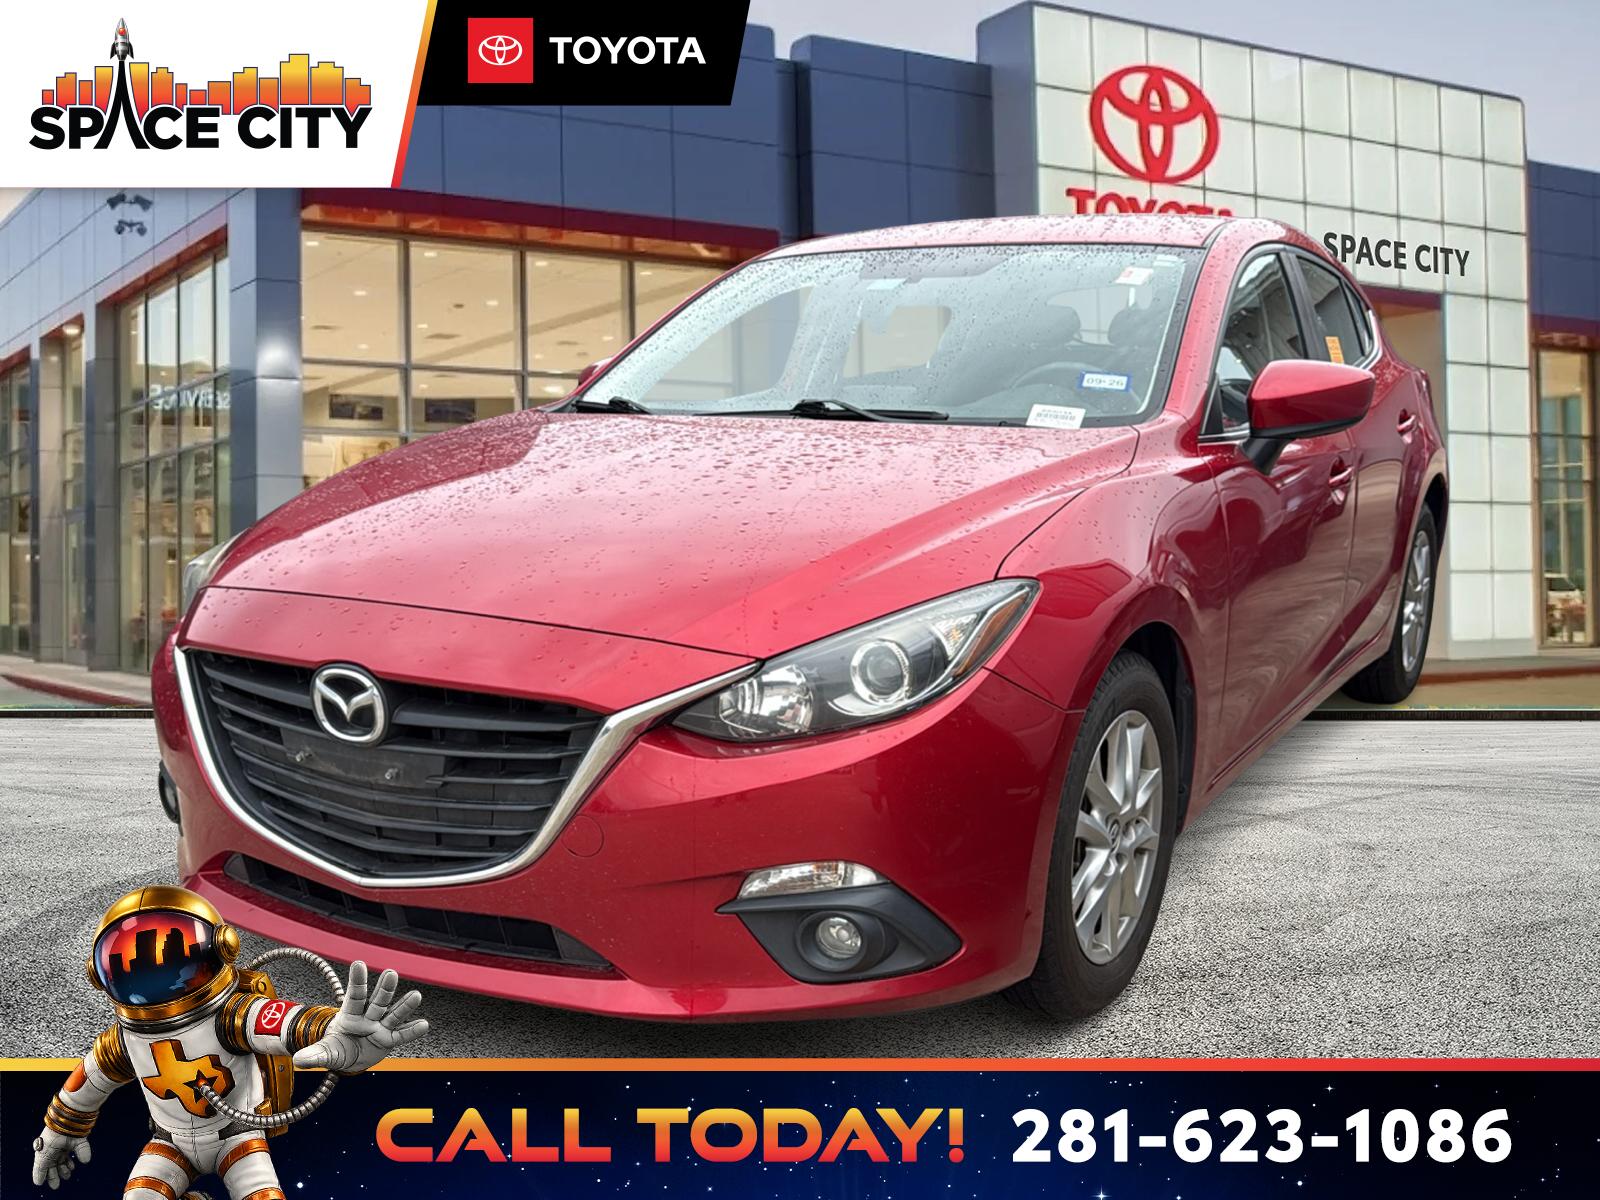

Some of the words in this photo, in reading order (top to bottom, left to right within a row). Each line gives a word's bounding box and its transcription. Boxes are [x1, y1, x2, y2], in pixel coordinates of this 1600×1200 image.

[1065, 187, 1233, 217] TOY
[1323, 232, 1408, 270] SPACE
[1414, 244, 1471, 277] CITY
